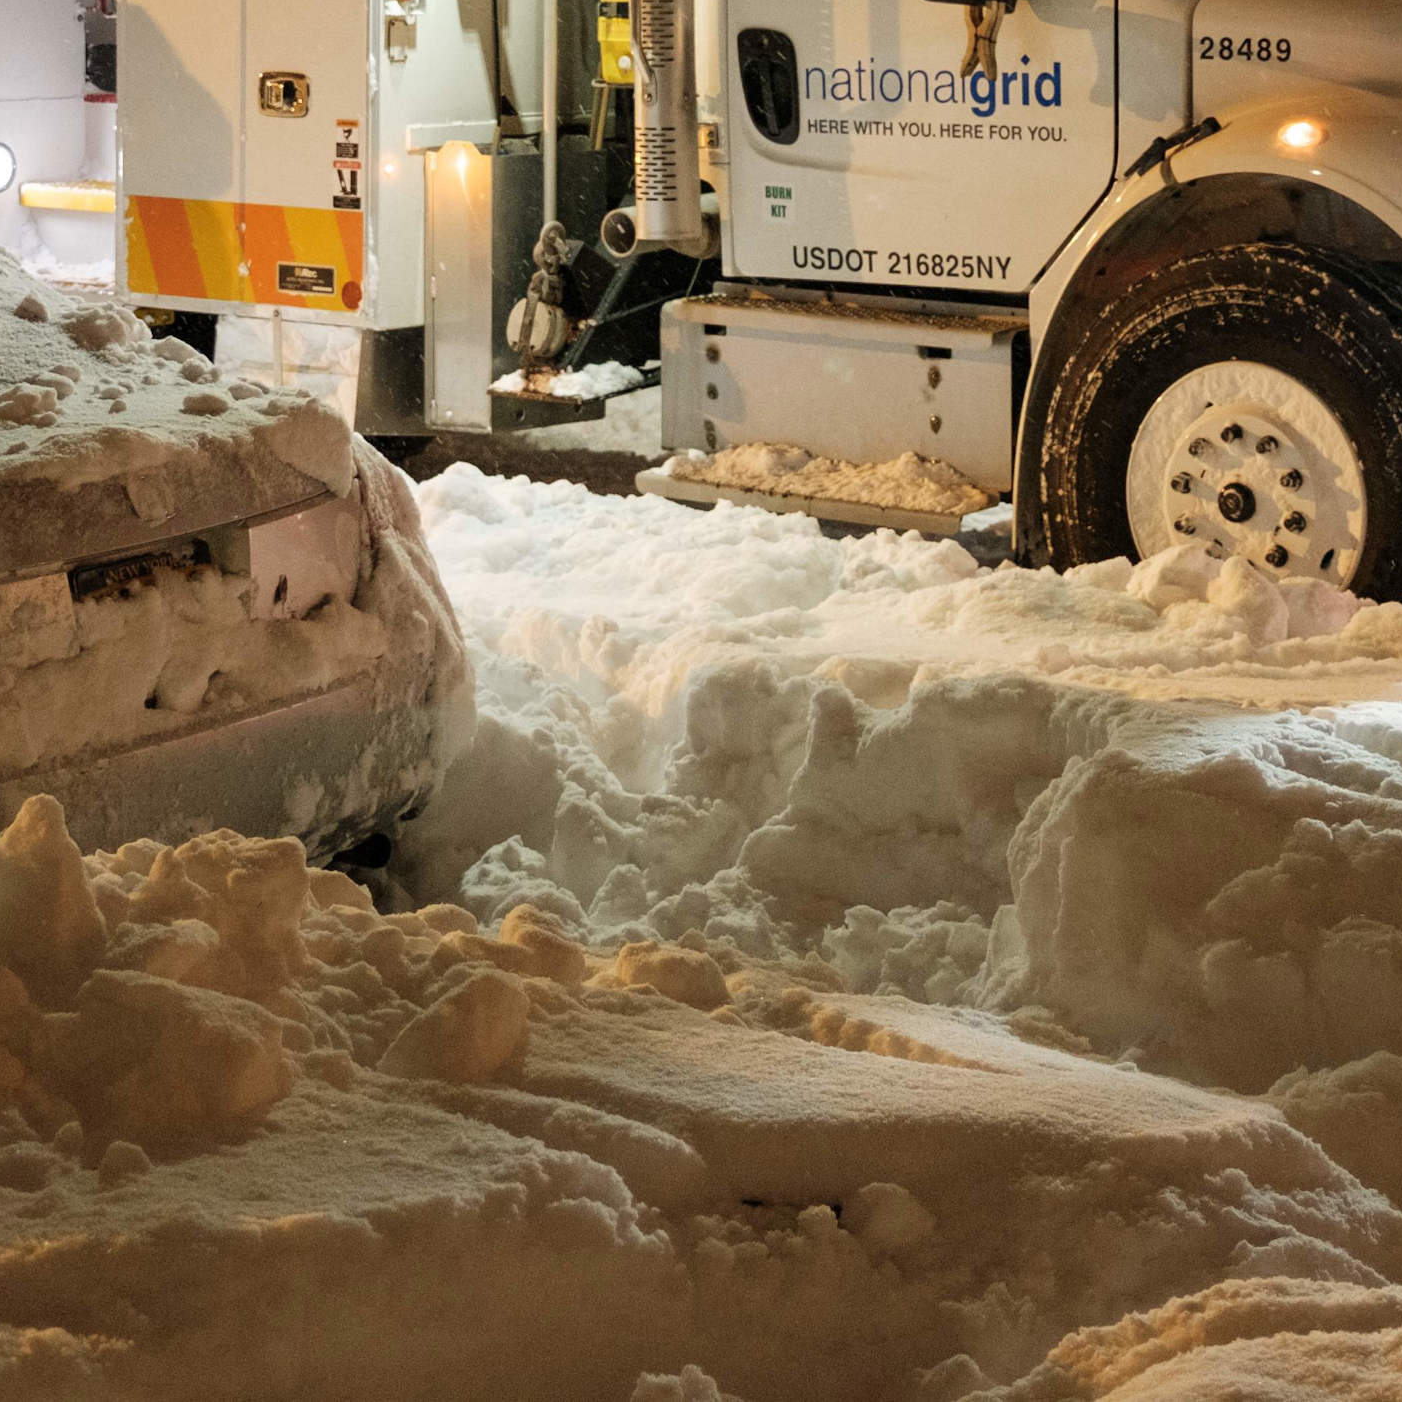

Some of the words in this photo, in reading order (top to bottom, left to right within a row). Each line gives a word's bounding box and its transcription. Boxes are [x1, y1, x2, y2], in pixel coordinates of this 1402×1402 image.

[1200, 36, 1291, 62] 28489
[805, 54, 1062, 117] nationalgrid
[807, 119, 849, 135] HERE
[853, 120, 893, 136] WITH
[898, 122, 936, 138] YOU.
[940, 124, 984, 139] HERE
[989, 125, 1022, 140] FOR
[1027, 126, 1067, 142] YOU.
[765, 186, 792, 200] BURN
[771, 205, 787, 217] KIT
[792, 246, 878, 273] USDOT
[888, 252, 1011, 279] 216825NY
